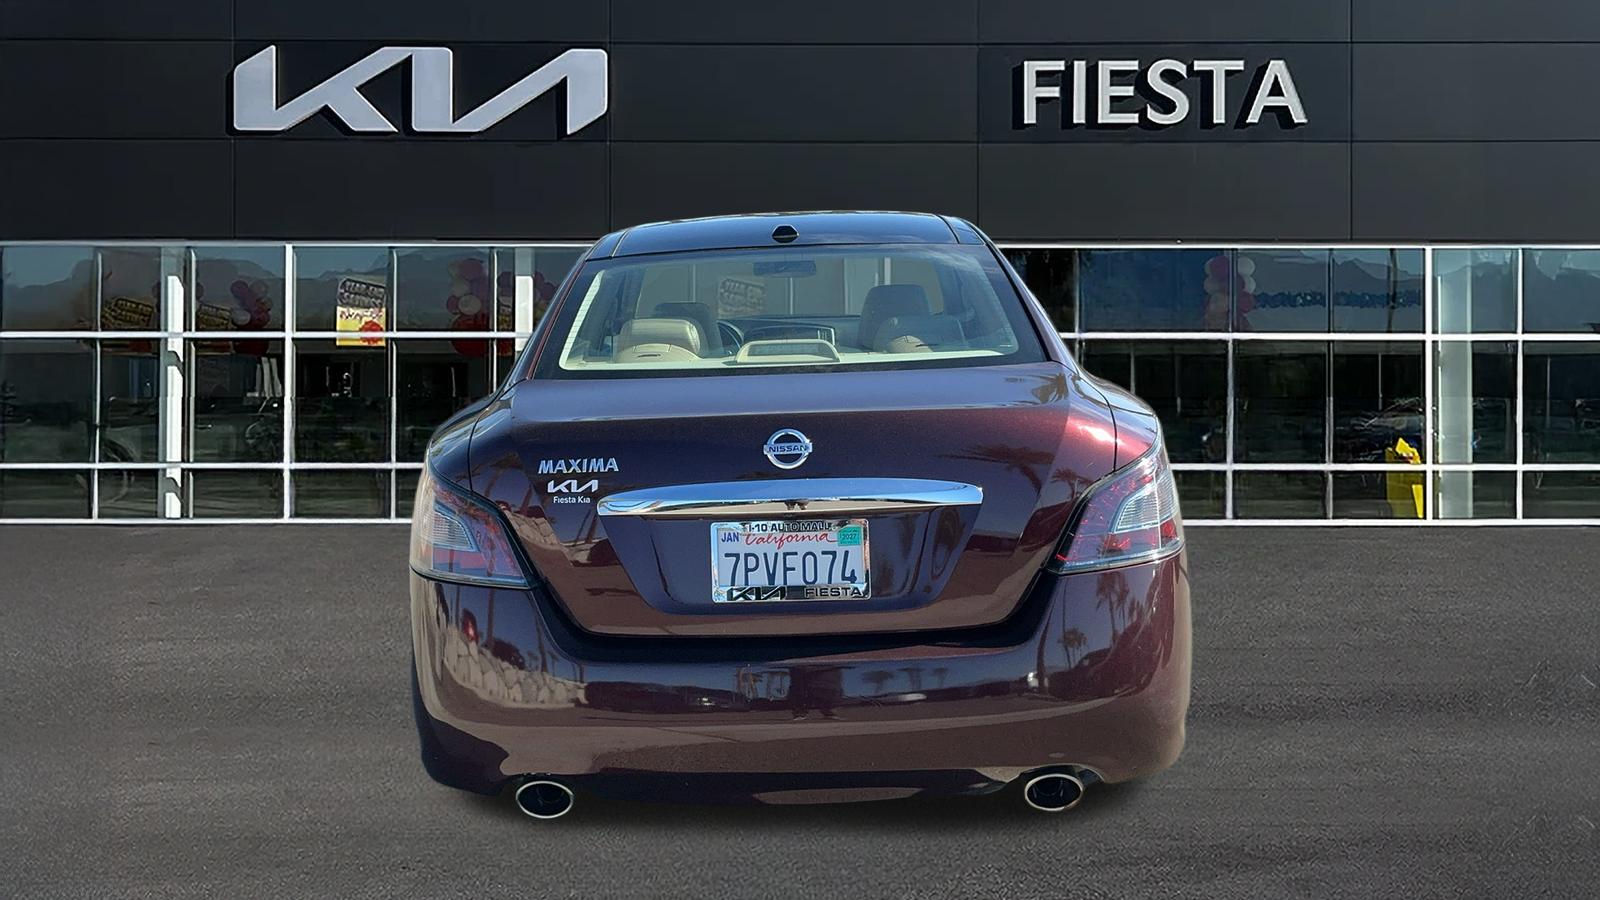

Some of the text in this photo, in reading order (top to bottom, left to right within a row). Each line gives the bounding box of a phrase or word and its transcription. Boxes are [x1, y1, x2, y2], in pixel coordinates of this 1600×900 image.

[233, 45, 608, 135] KIA
[1023, 59, 1308, 124] FIESTA
[538, 457, 620, 474] MAXIMA
[547, 479, 599, 493] KIA
[553, 496, 591, 504] Fiesta Kia
[749, 521, 832, 533] I-10 AUTO MALL
[721, 532, 740, 543] JAN
[745, 532, 839, 550] California
[724, 550, 857, 587] 7PVF074
[805, 587, 865, 598] FIESTA
